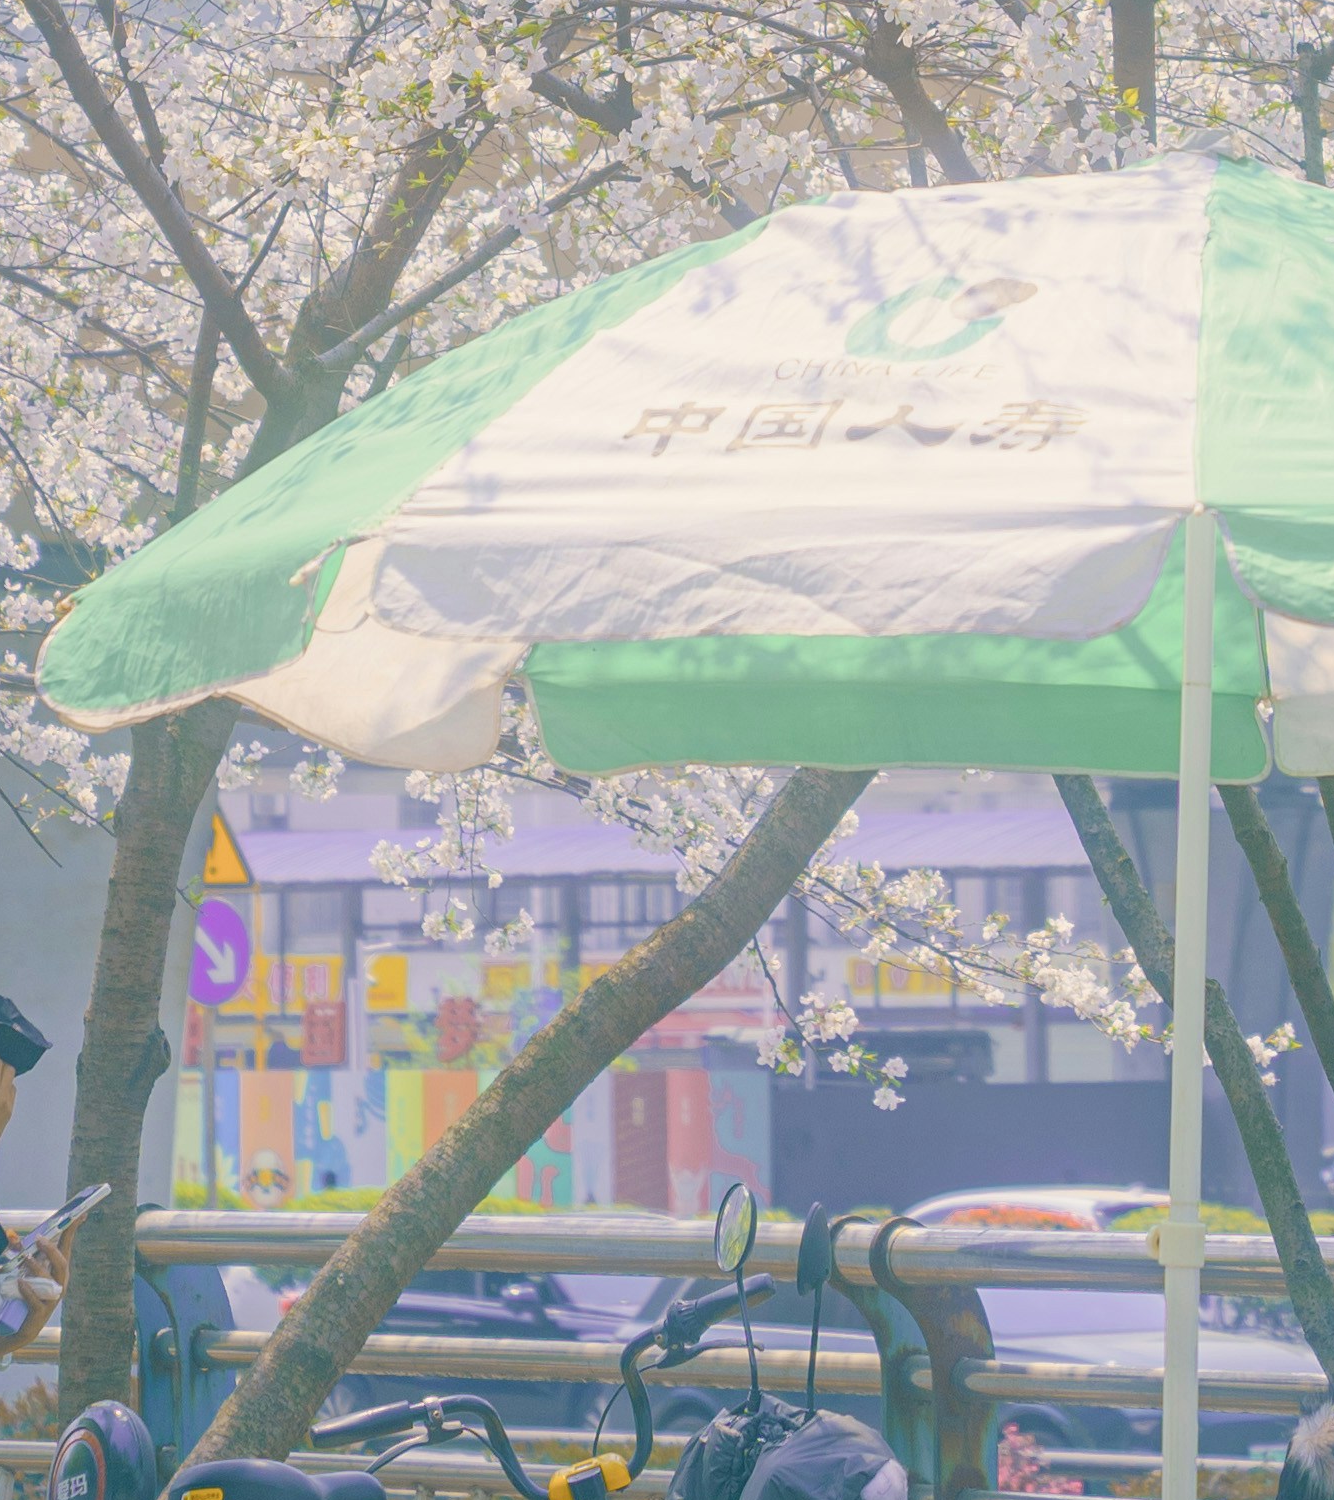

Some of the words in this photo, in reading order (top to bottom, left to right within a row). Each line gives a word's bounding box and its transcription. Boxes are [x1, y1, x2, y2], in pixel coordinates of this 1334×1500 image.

[774, 358, 892, 381] CHINA
[912, 361, 1004, 380] LIFE
[622, 398, 1090, 458] 中国人寿
